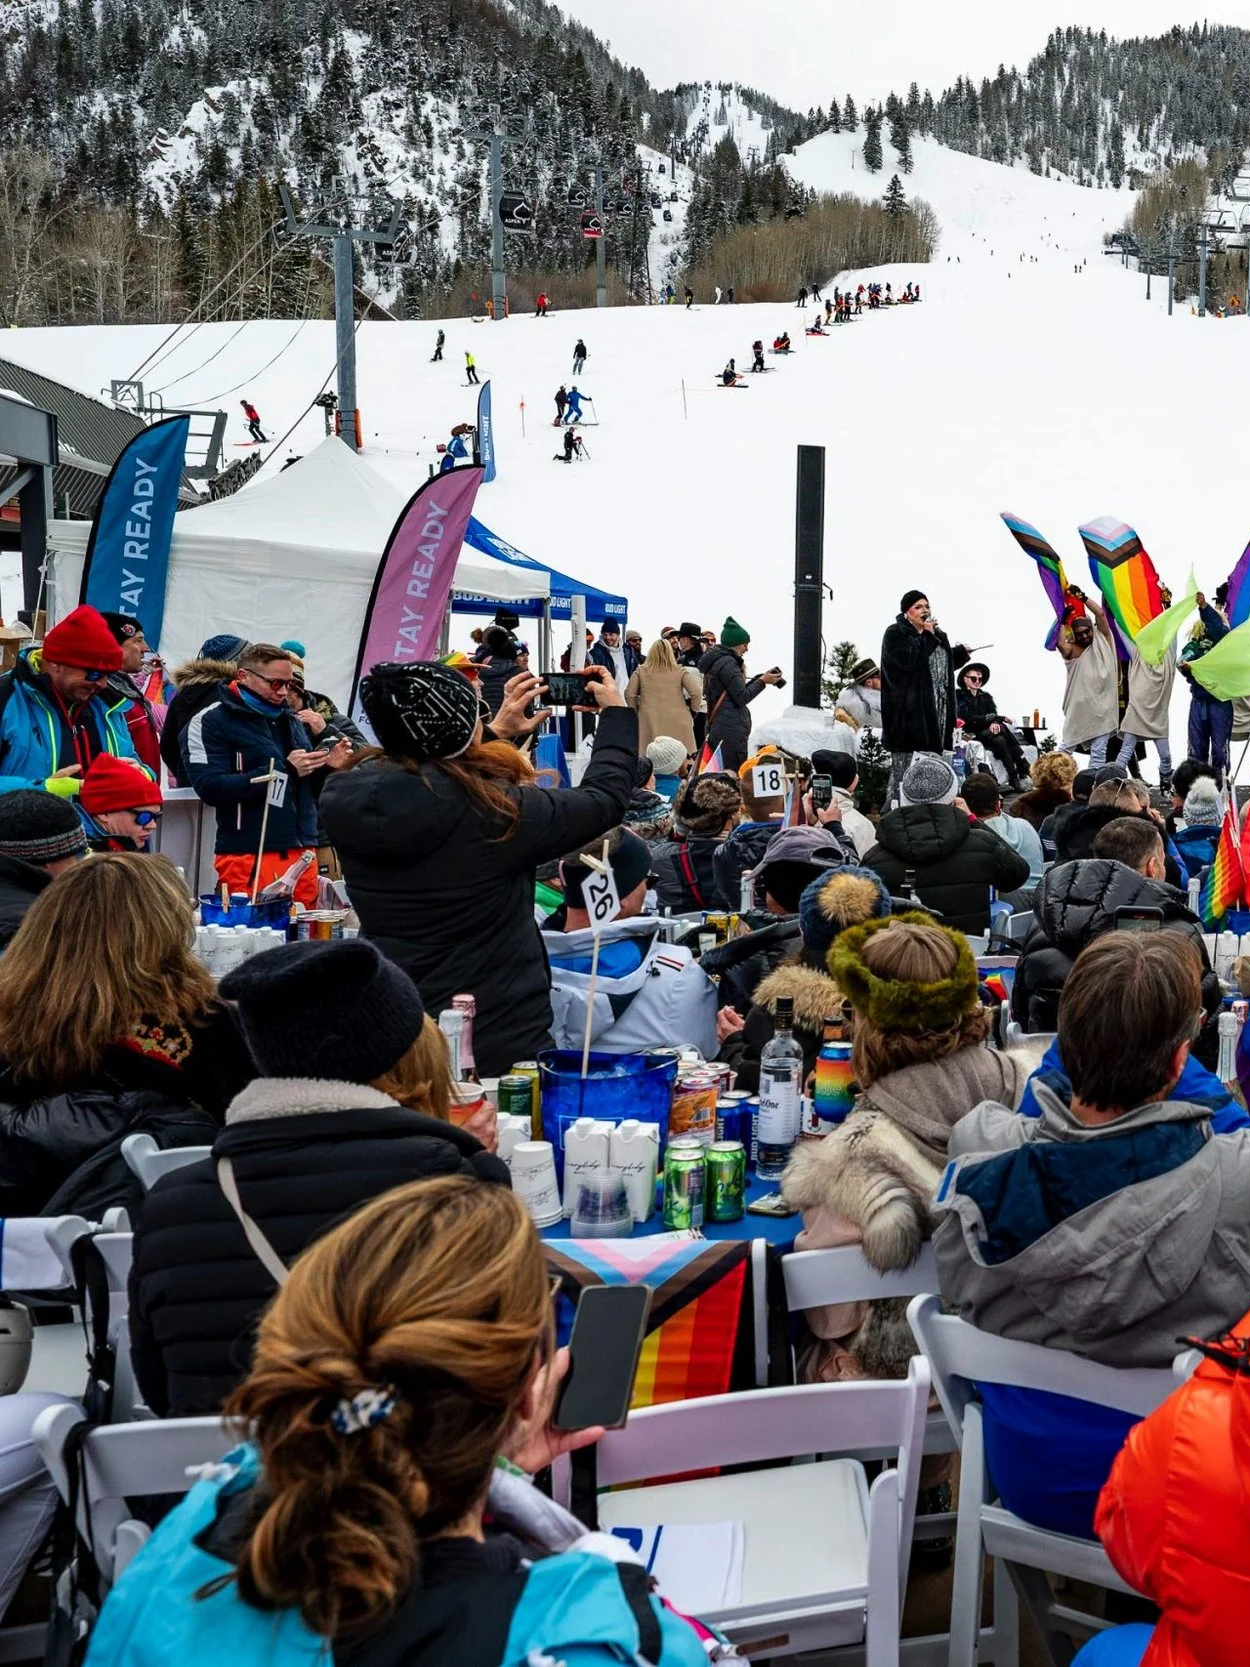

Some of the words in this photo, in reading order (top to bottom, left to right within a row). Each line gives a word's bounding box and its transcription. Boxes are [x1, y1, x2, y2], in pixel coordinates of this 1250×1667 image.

[124, 457, 158, 560] READY
[406, 500, 449, 599] READY
[119, 568, 145, 618] TAY
[394, 606, 424, 664] TAY
[273, 777, 285, 800] 17
[758, 770, 780, 791] 18
[589, 873, 613, 920] 26
